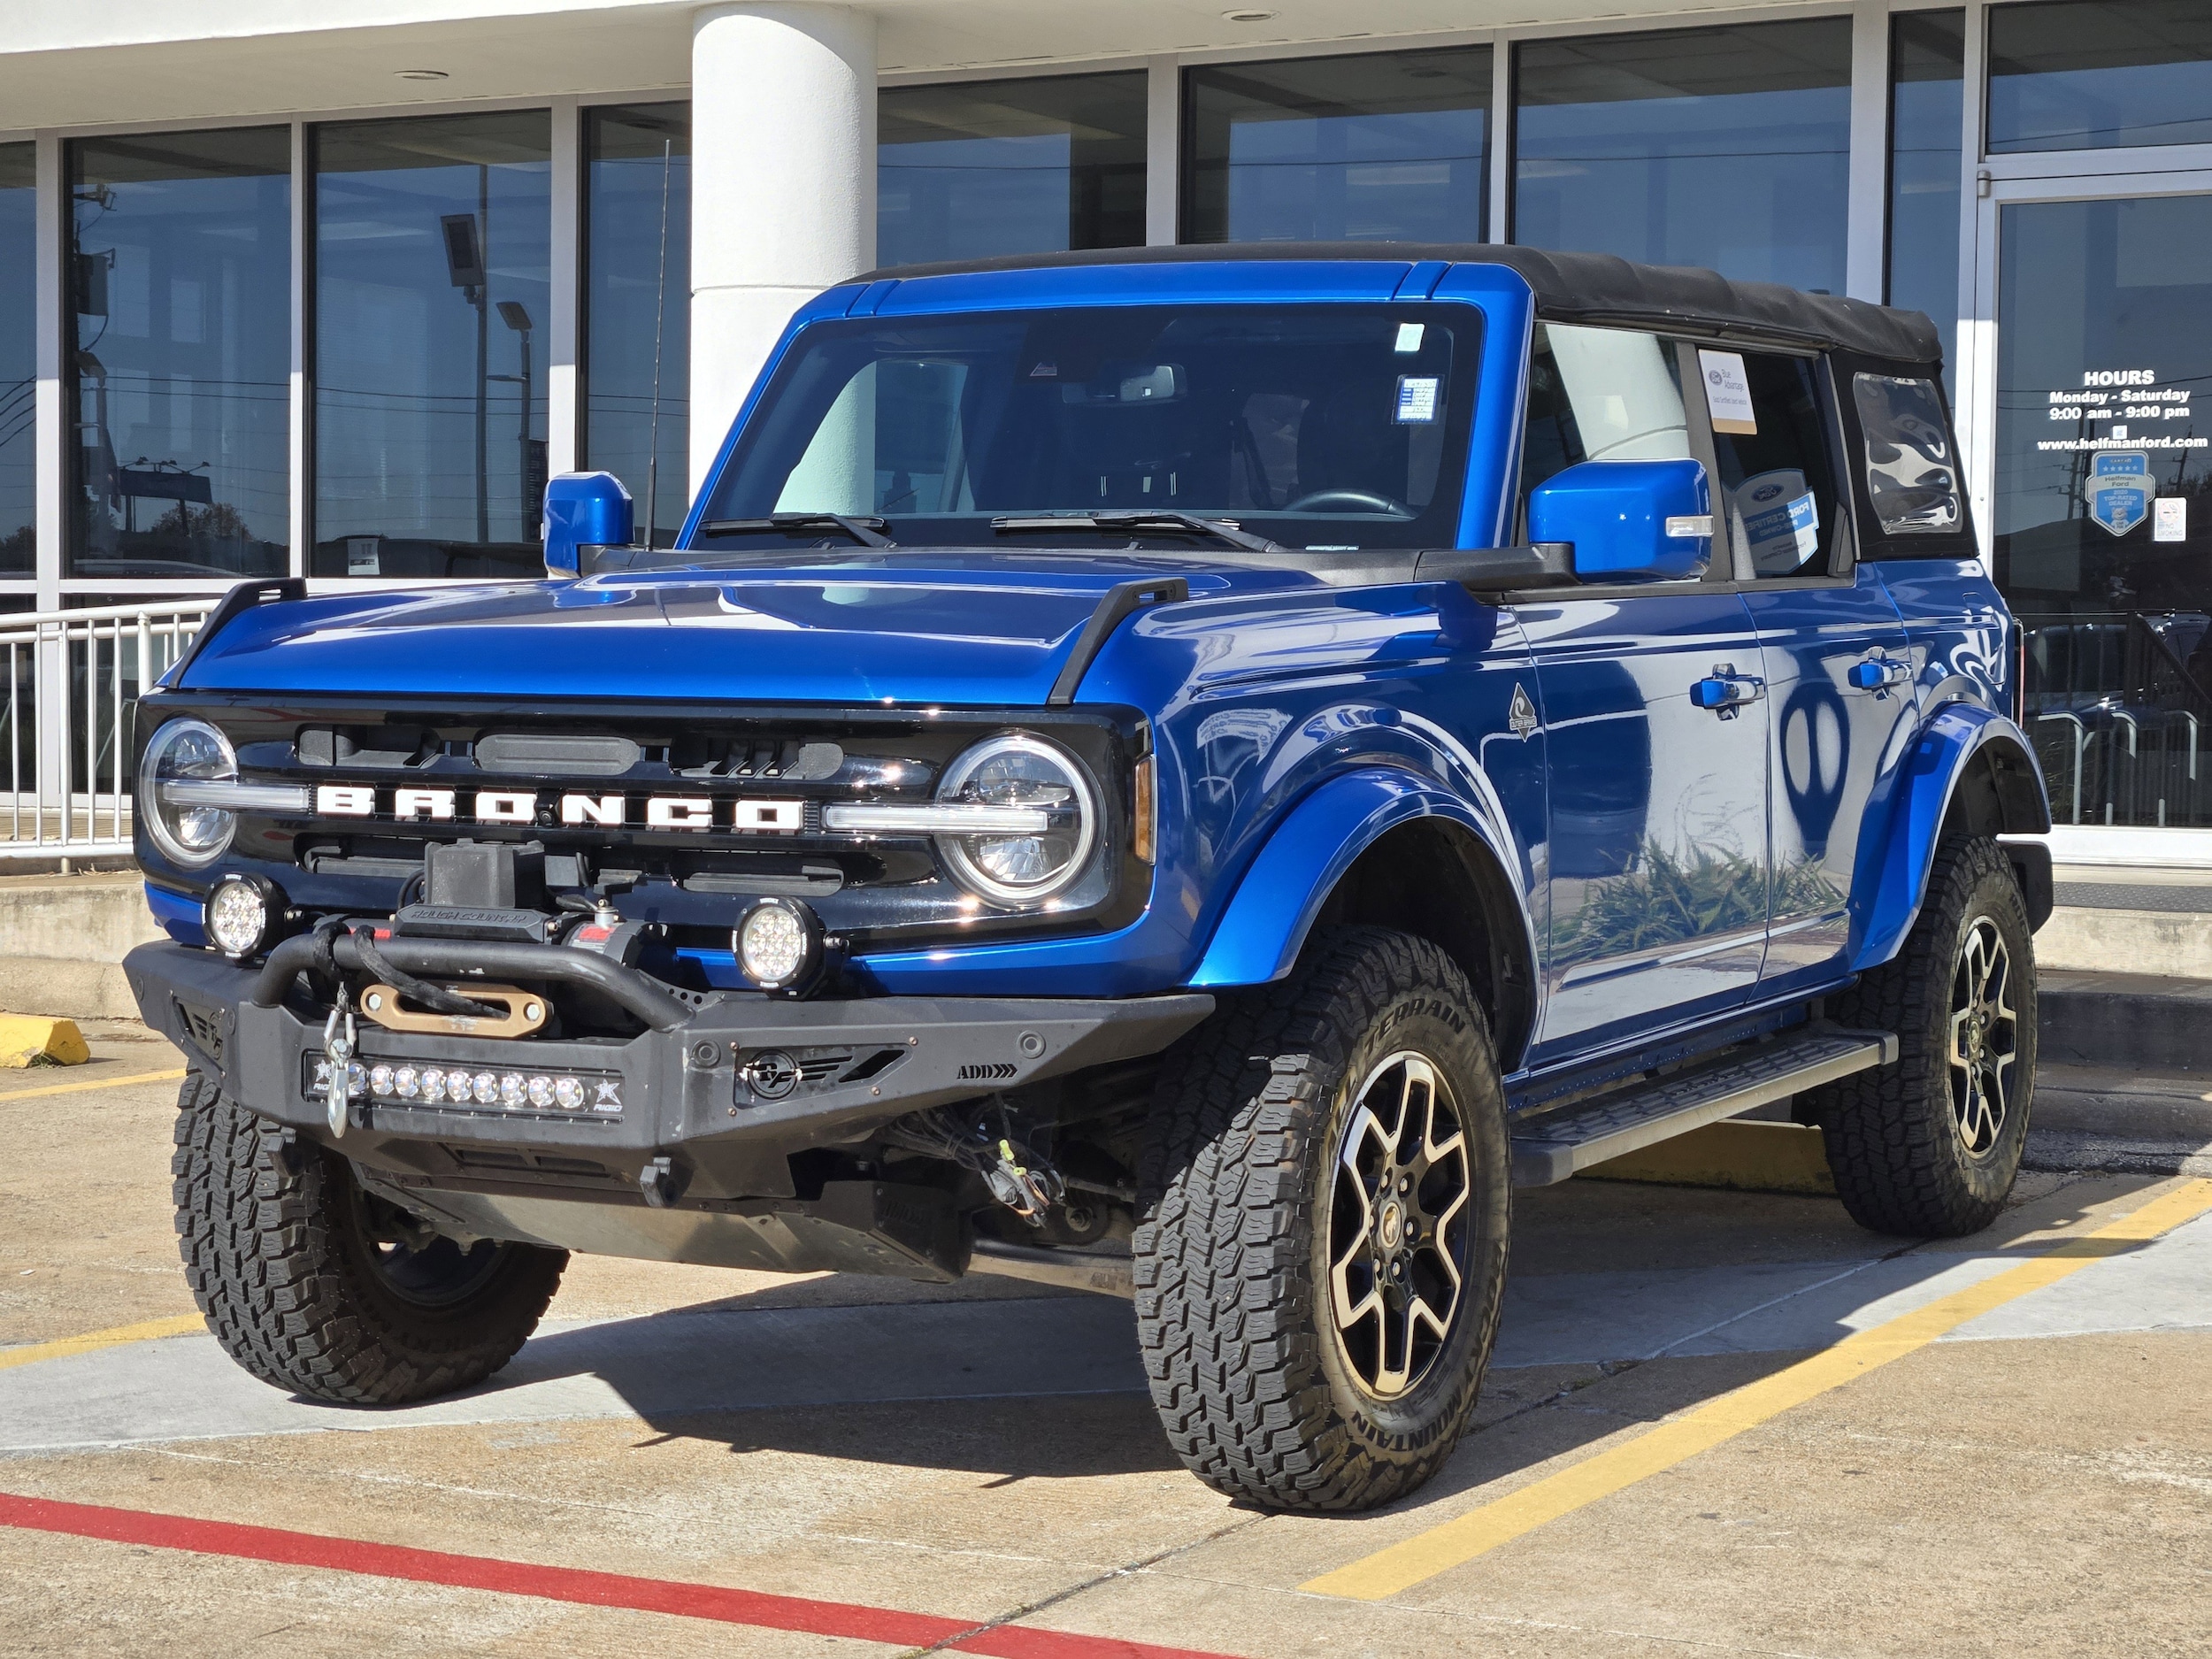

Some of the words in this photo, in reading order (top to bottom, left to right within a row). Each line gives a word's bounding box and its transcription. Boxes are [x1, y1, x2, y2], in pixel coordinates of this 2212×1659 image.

[2084, 369, 2155, 387] HOURS
[2049, 390, 2109, 405] Monday
[2121, 388, 2191, 403] Saturday
[2049, 406, 2083, 420] 9:00
[2086, 409, 2112, 419] am
[2125, 405, 2161, 419] 9:00
[2163, 407, 2190, 420] pm
[2037, 435, 2208, 450] www.helfmanford.com
[316, 784, 803, 830] BRONCO
[411, 910, 460, 920] ROUGH
[460, 912, 527, 923] COUNTRY
[1363, 997, 1467, 1056] TERRAIN
[312, 1082, 332, 1091] RIG
[593, 1103, 624, 1112] RIGID
[1350, 1385, 1464, 1454] MOUNTAIN
